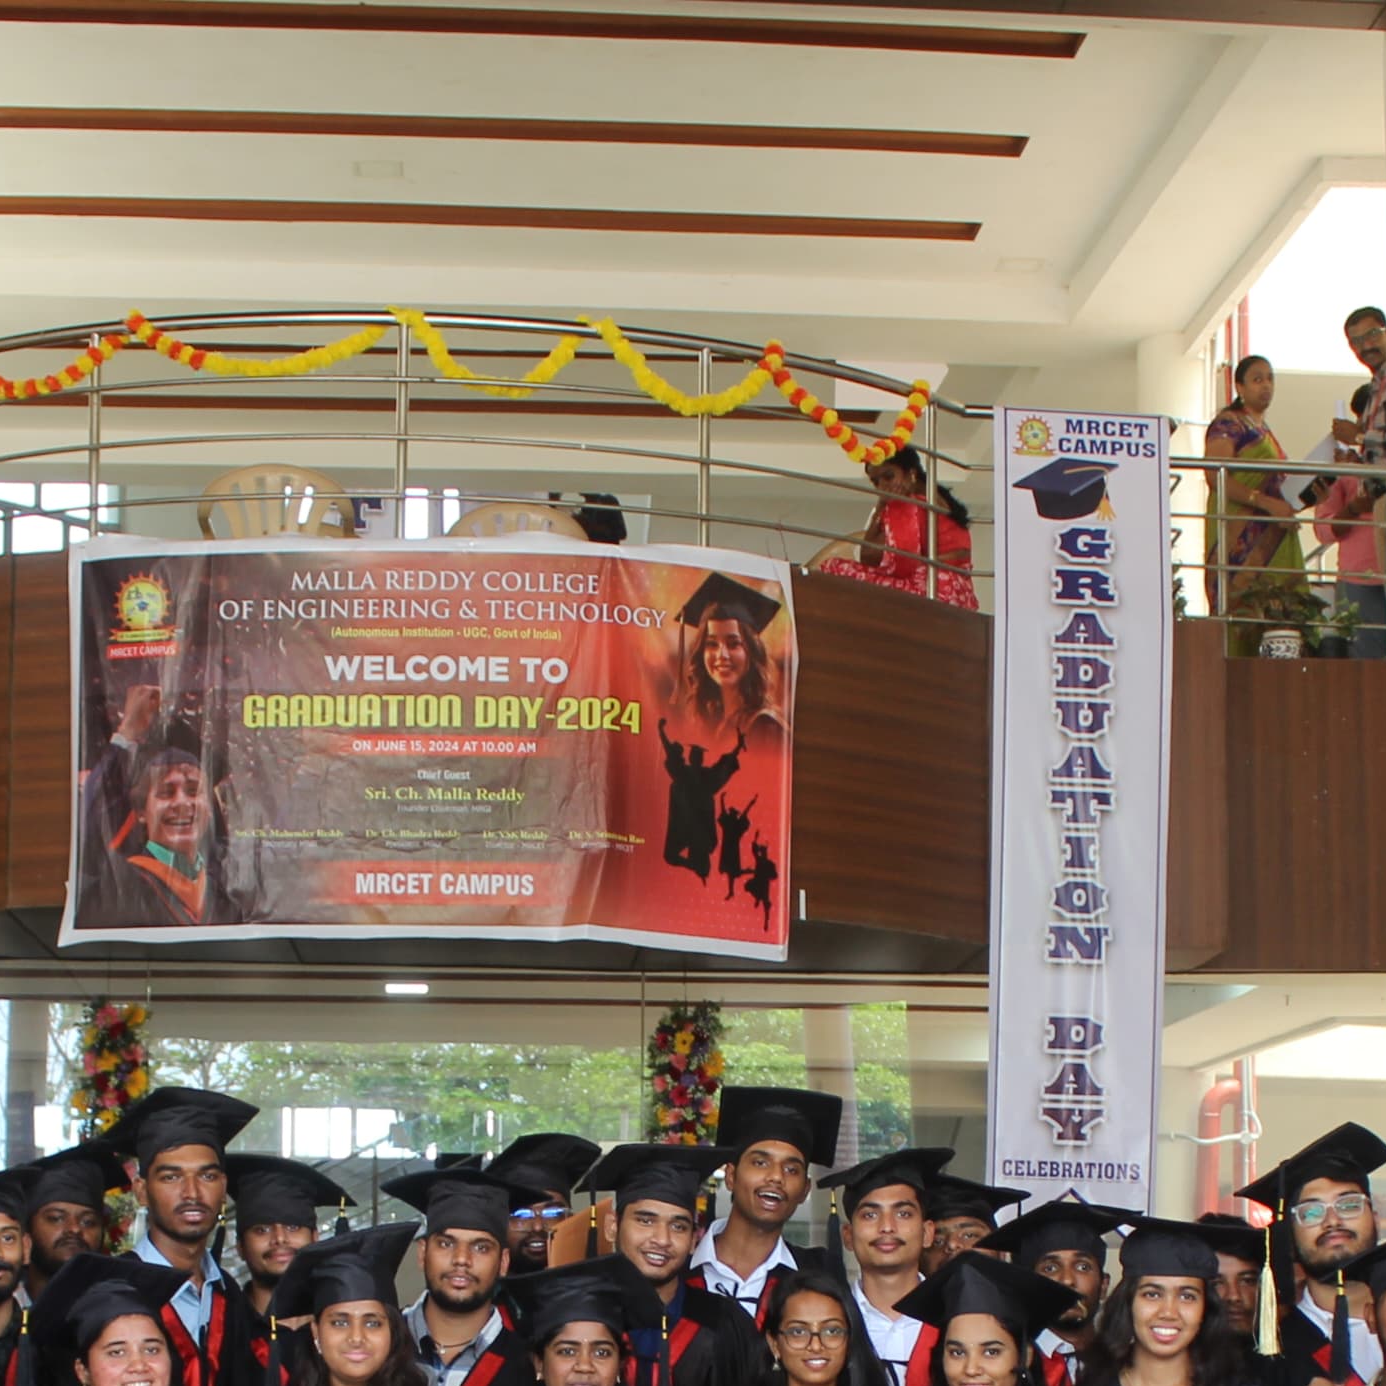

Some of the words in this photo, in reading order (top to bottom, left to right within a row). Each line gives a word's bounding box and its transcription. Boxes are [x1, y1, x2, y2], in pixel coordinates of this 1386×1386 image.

[1065, 418, 1149, 438] MRCET
[1058, 438, 1157, 458] CAMPUS
[290, 571, 376, 591] MALLA
[378, 571, 476, 591] REDDY
[482, 572, 599, 595] COLLEGE
[218, 600, 254, 621] OF
[263, 599, 450, 621] ENGINEERING
[459, 599, 478, 620] &
[483, 600, 667, 629] TECHNOLOGY
[331, 626, 400, 639] (Autonomous
[402, 626, 454, 639] Institution
[493, 627, 518, 640] Govt
[519, 627, 531, 640] of
[532, 628, 562, 642] India)
[324, 655, 509, 682] WELCOME
[520, 657, 569, 684] TO
[242, 693, 462, 729] GRADUATION
[473, 694, 642, 734] DAY-2024
[352, 739, 372, 751] ON
[374, 740, 407, 752] JUNE
[410, 740, 426, 753] 15,
[428, 740, 459, 752] 2024
[461, 740, 478, 752] AT
[481, 740, 515, 753] 10.00
[517, 741, 537, 753] AM
[1045, 525, 1118, 965] GRADUATION
[417, 769, 442, 780] Chief
[444, 769, 470, 781] Guest
[365, 786, 390, 801] Sri.
[395, 786, 422, 801] Ch.
[427, 786, 472, 801] Malla
[476, 787, 526, 804] Reddy
[355, 872, 432, 895] MRCET
[439, 873, 534, 896] CAMPUS
[1038, 1014, 1107, 1148] DAY
[1002, 1159, 1140, 1181] CELEBRATIONS
